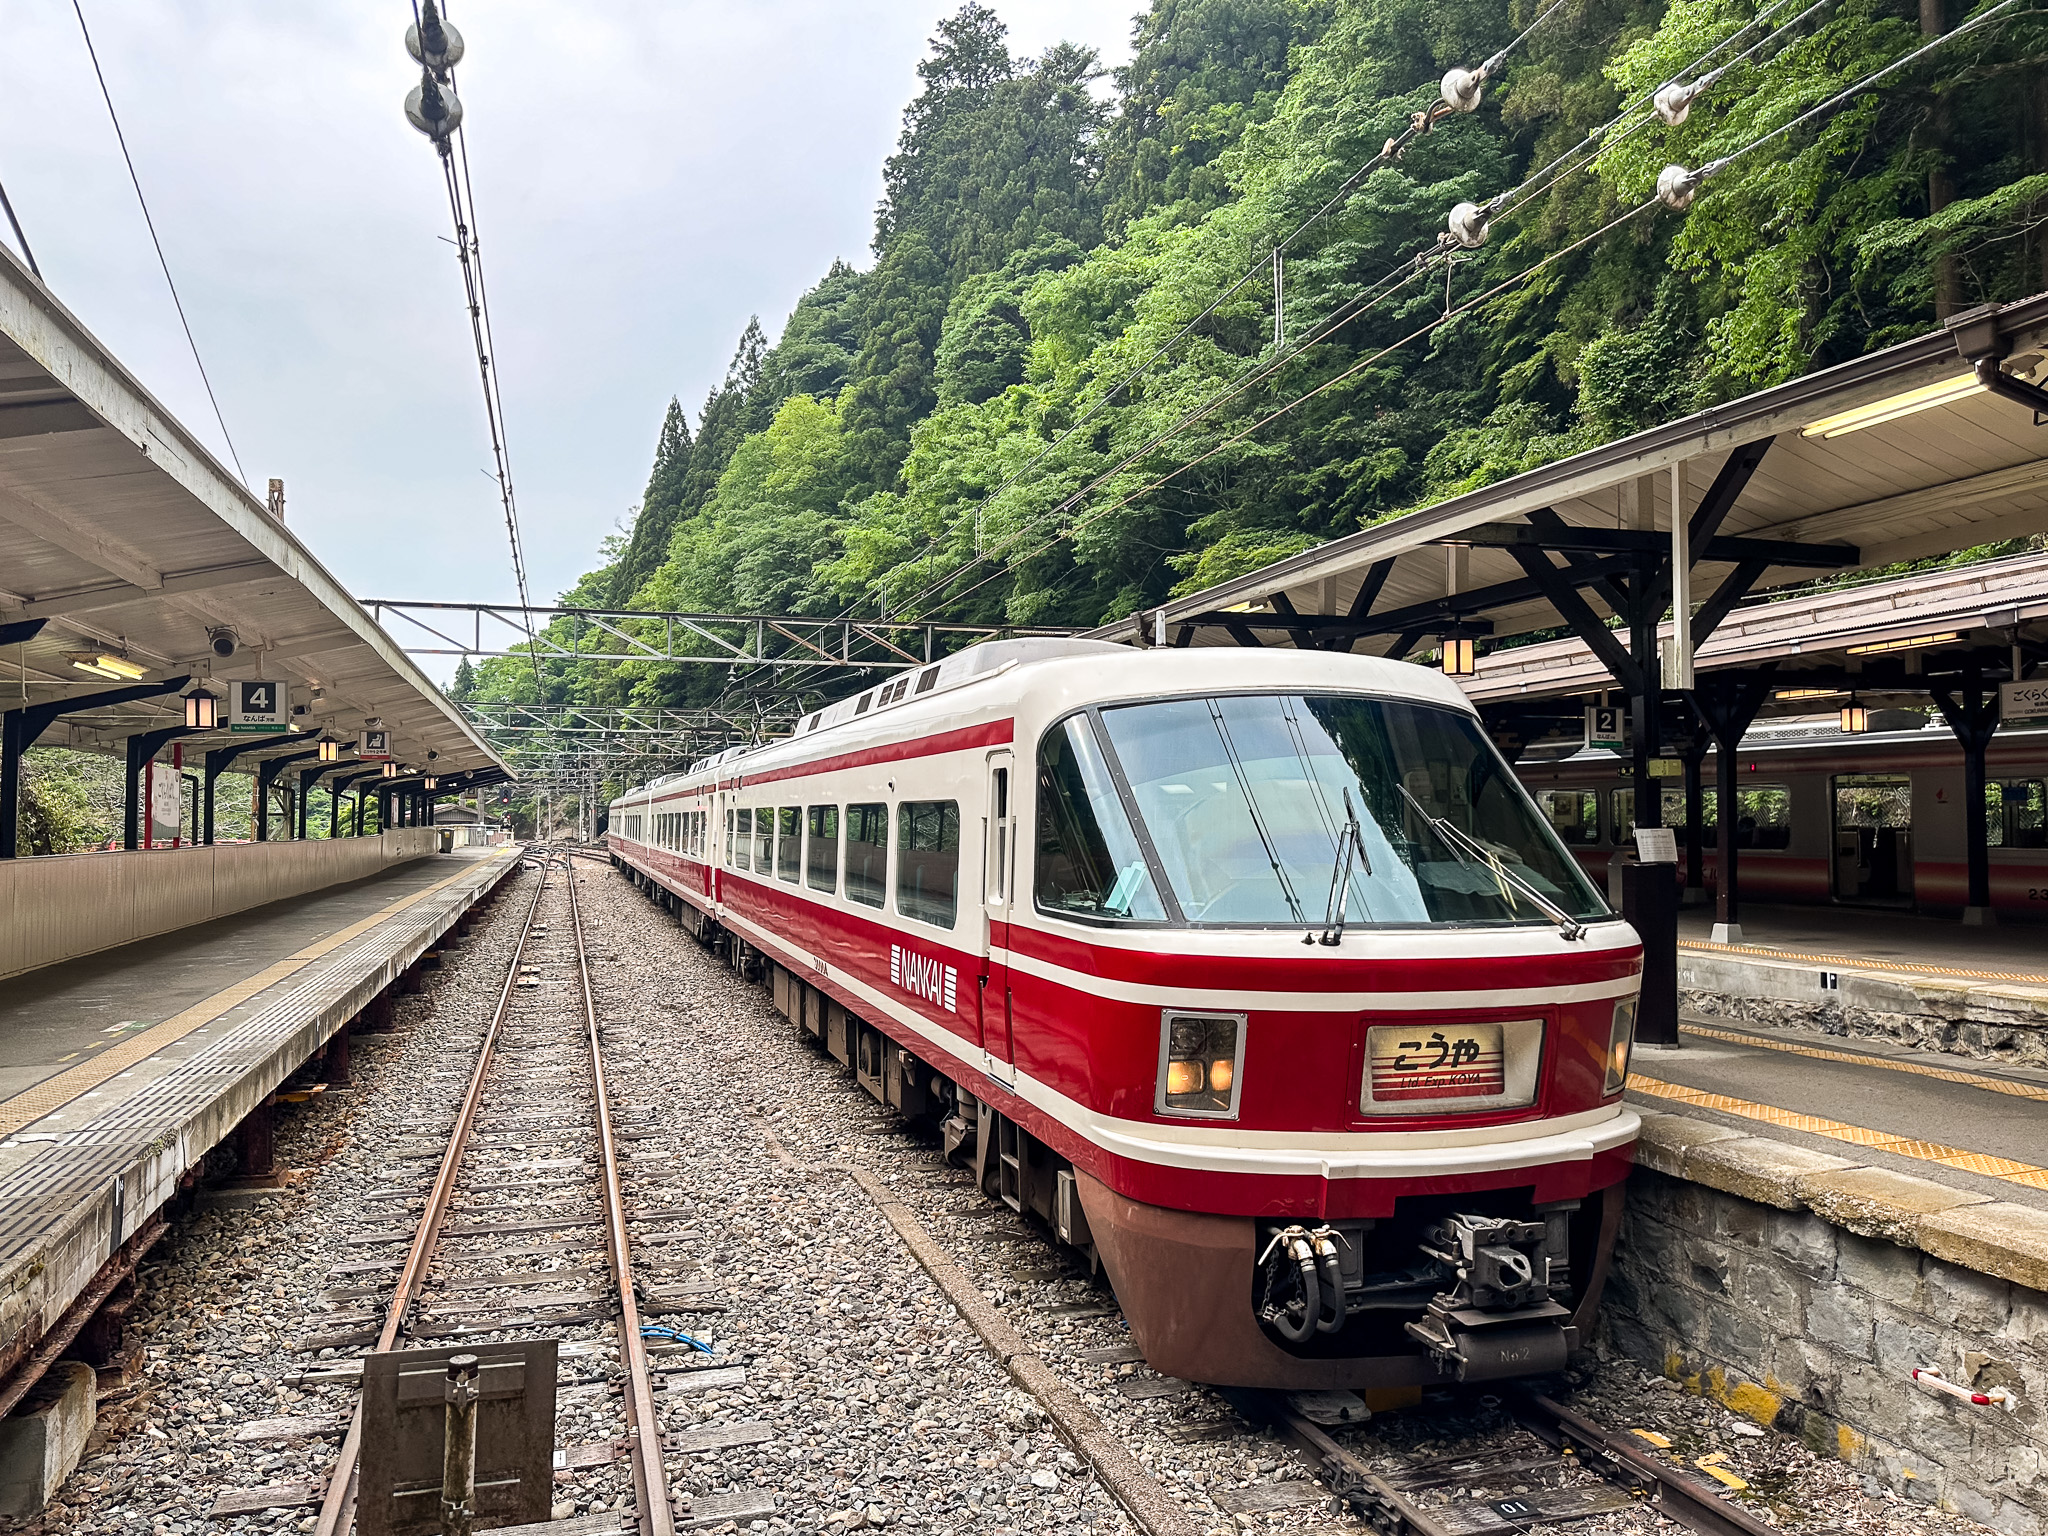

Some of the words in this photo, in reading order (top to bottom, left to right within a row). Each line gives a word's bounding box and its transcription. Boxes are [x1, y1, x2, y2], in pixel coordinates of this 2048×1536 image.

[249, 687, 269, 709] 4
[1601, 712, 1612, 729] 2
[901, 947, 943, 1007] NANKAI
[1393, 1031, 1481, 1072] こうや
[1400, 1077, 1421, 1089] Ltd.
[1448, 1073, 1481, 1085] KOYA
